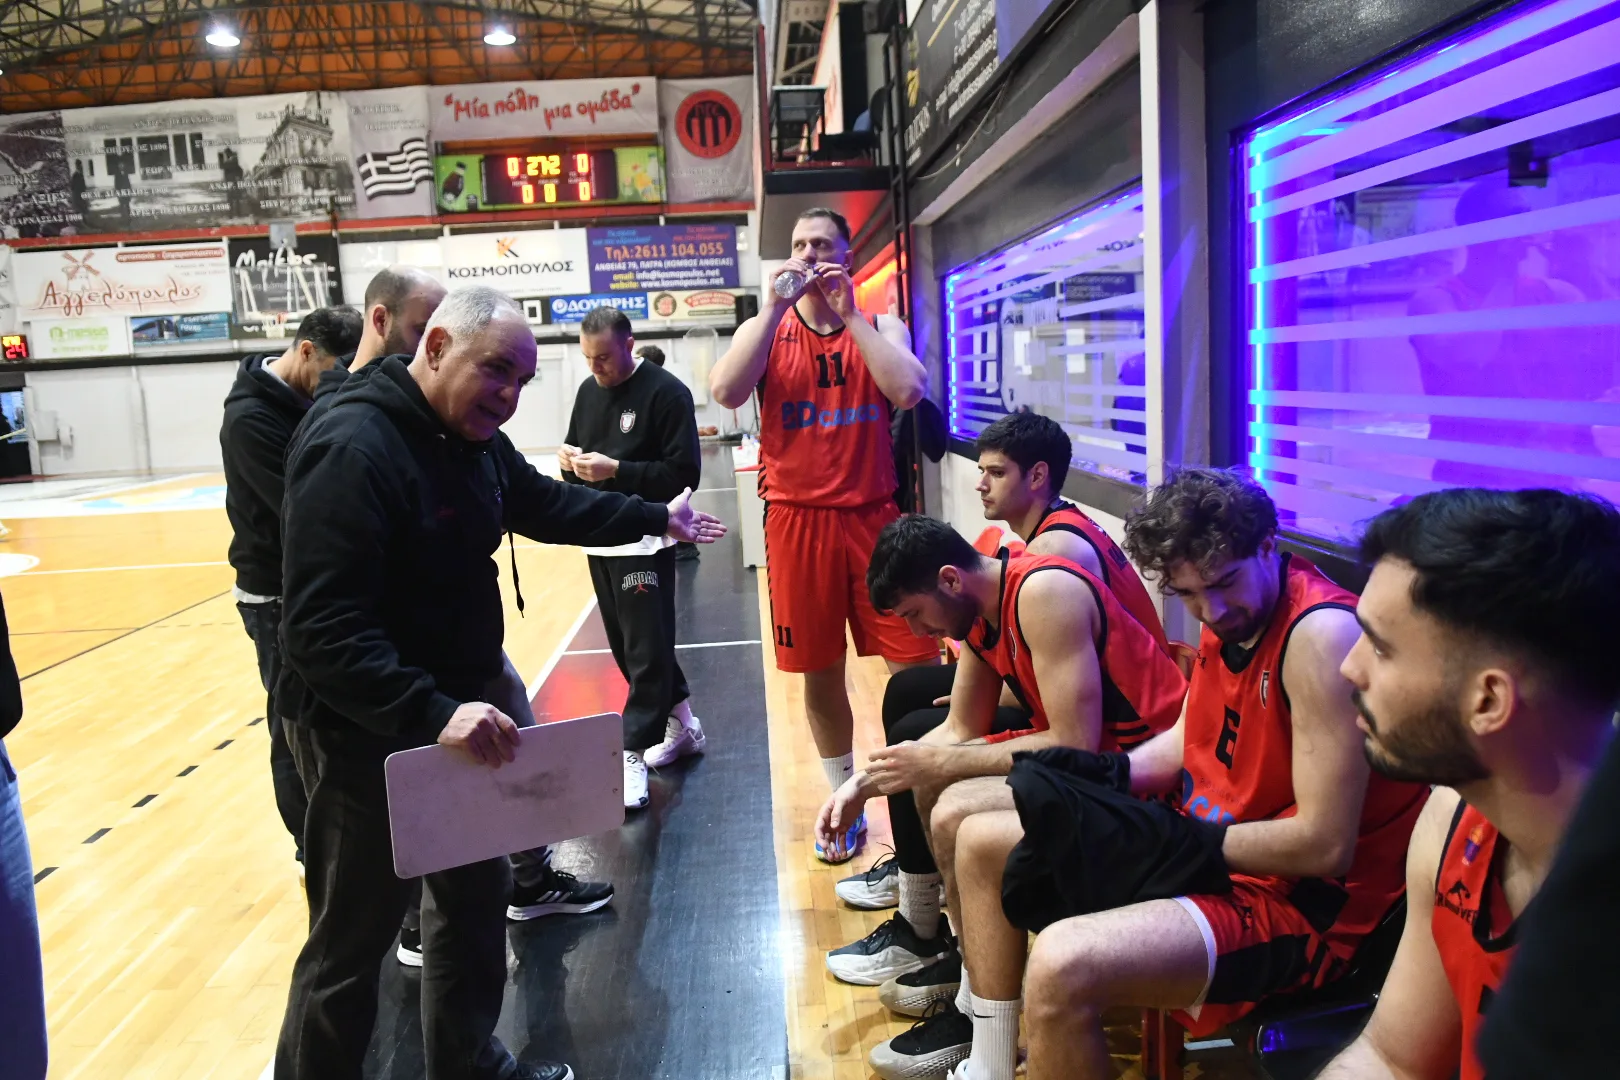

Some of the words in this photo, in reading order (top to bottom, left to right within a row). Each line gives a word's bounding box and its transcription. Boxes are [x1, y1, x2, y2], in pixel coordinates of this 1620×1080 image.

[507, 157, 519, 177] 0
[576, 153, 589, 173] 0
[522, 185, 534, 204] 0
[579, 181, 591, 201] 0
[671, 242, 724, 257] 104.055
[449, 260, 575, 279] ΚΟΣΜΟΠΟΥΛΟΣ
[6, 342, 26, 358] 24
[816, 352, 846, 388] 11
[622, 571, 659, 591] JORDAN
[776, 625, 794, 648] 11
[1215, 704, 1241, 770] 6
